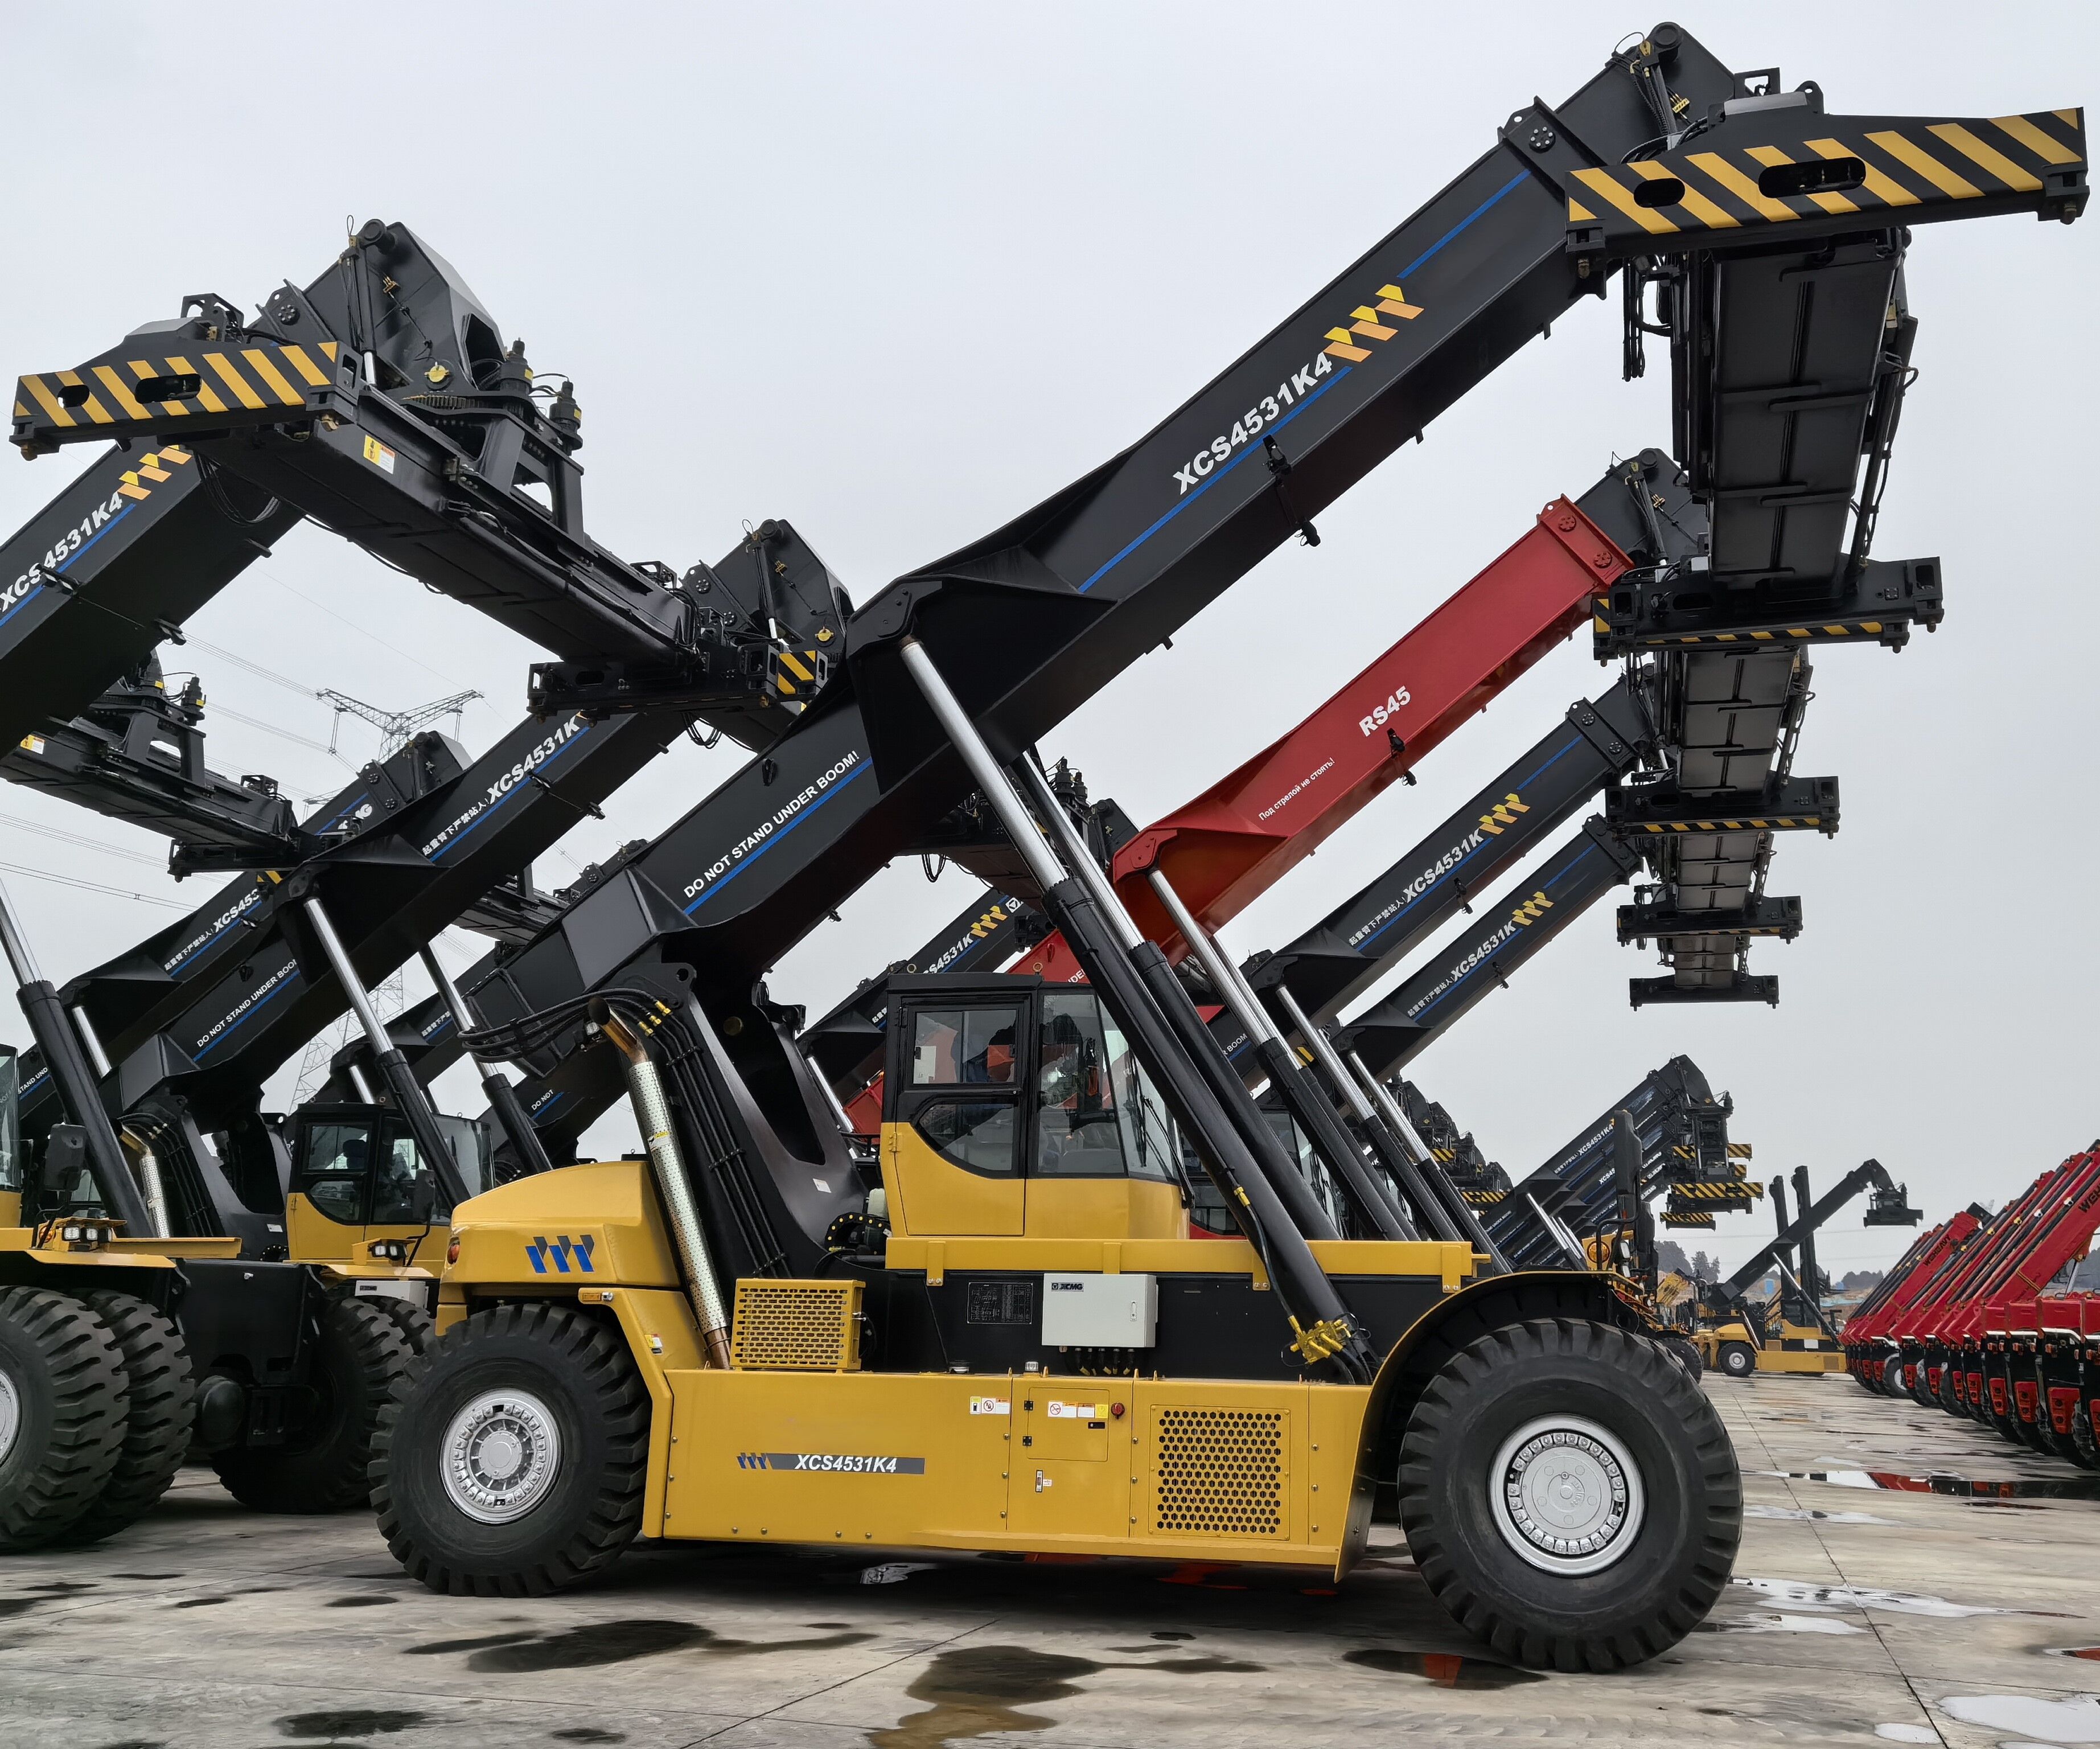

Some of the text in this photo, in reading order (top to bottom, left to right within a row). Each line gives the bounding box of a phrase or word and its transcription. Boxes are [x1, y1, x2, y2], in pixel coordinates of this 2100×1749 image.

[1173, 351, 1333, 495] XCS4531K4
[0, 491, 122, 613] XCS4531K4
[1359, 685, 1411, 737] RS45
[487, 715, 580, 804] XCS4531K
[1258, 757, 1335, 820] Под стрелой не стоять!
[684, 750, 860, 898] DO NOT STAND UNDER BOOM!
[1403, 828, 1485, 903] XCS4531K
[923, 933, 973, 974] S4531K
[1451, 920, 1517, 982] XCS4531K
[197, 959, 297, 1047] DO NOT STAND UNDER BOO
[1227, 1033, 1247, 1052] BOOM
[531, 1089, 553, 1110] DO NOT
[795, 1454, 897, 1473] XCS4531K4
